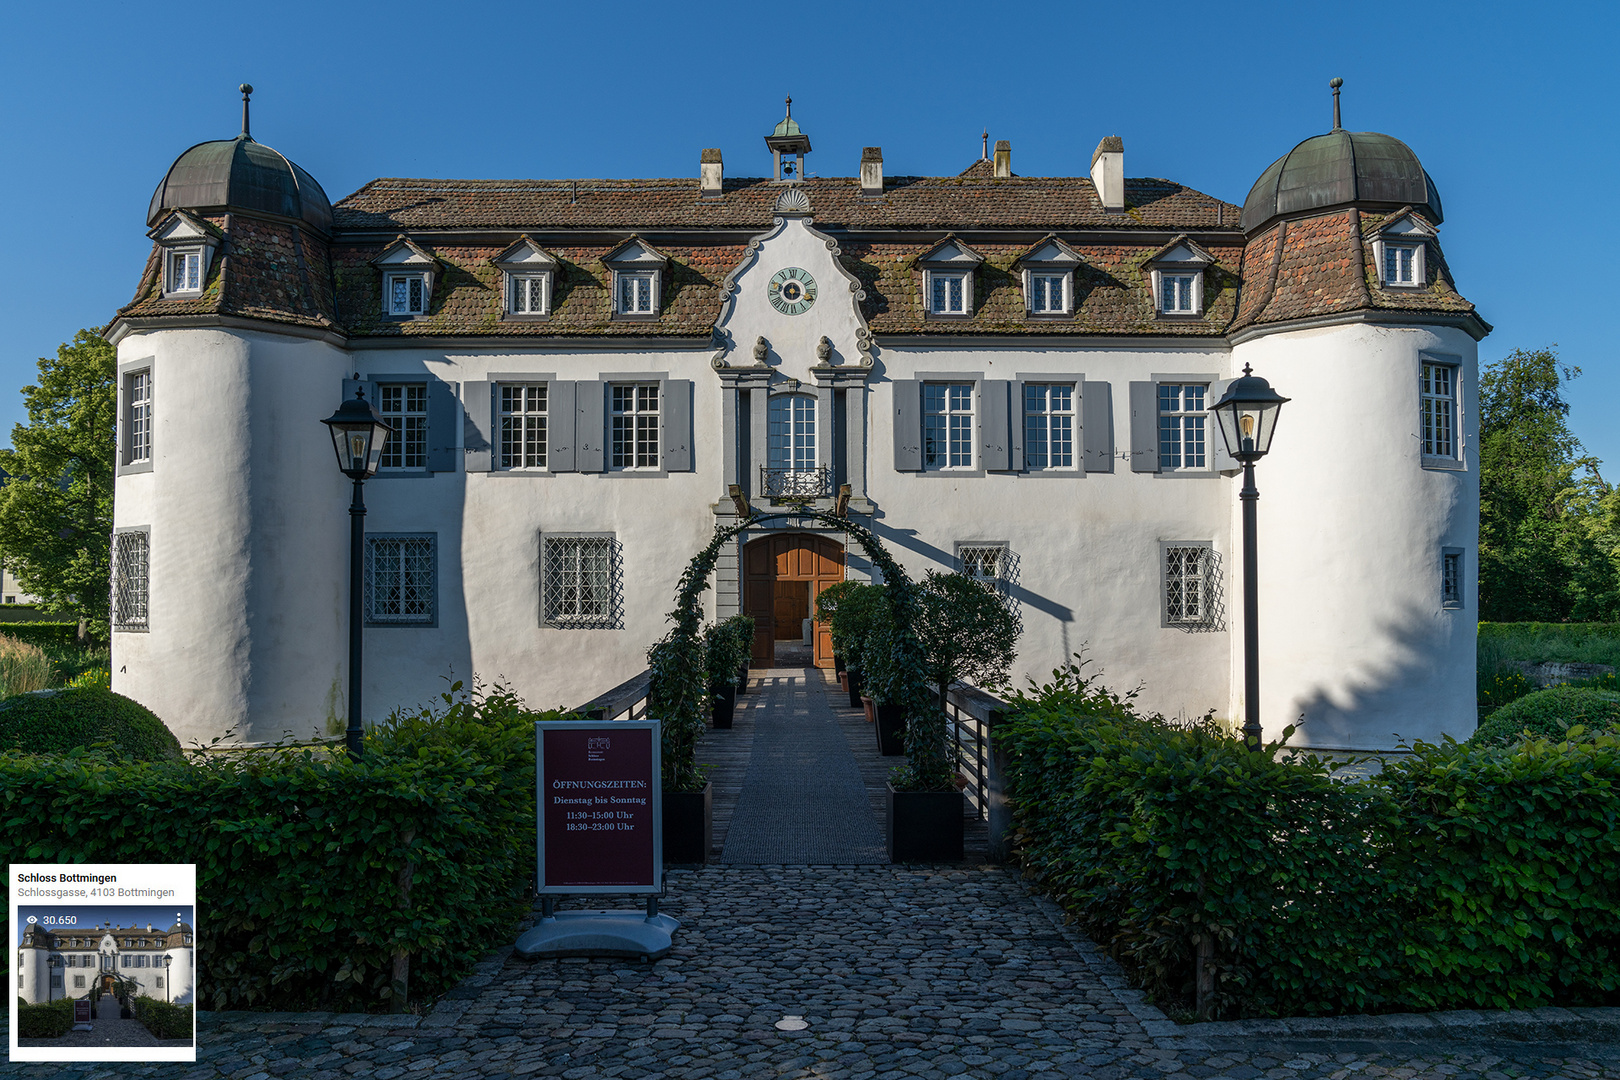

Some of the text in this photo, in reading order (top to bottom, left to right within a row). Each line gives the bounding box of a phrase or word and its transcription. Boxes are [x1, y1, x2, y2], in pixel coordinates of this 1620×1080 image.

[552, 779, 647, 789] ÖFFNUNGSZEITEN:
[553, 795, 647, 806] Dienstag bis Sonntag
[616, 811, 634, 819] Uhr
[617, 823, 635, 831] Uhr
